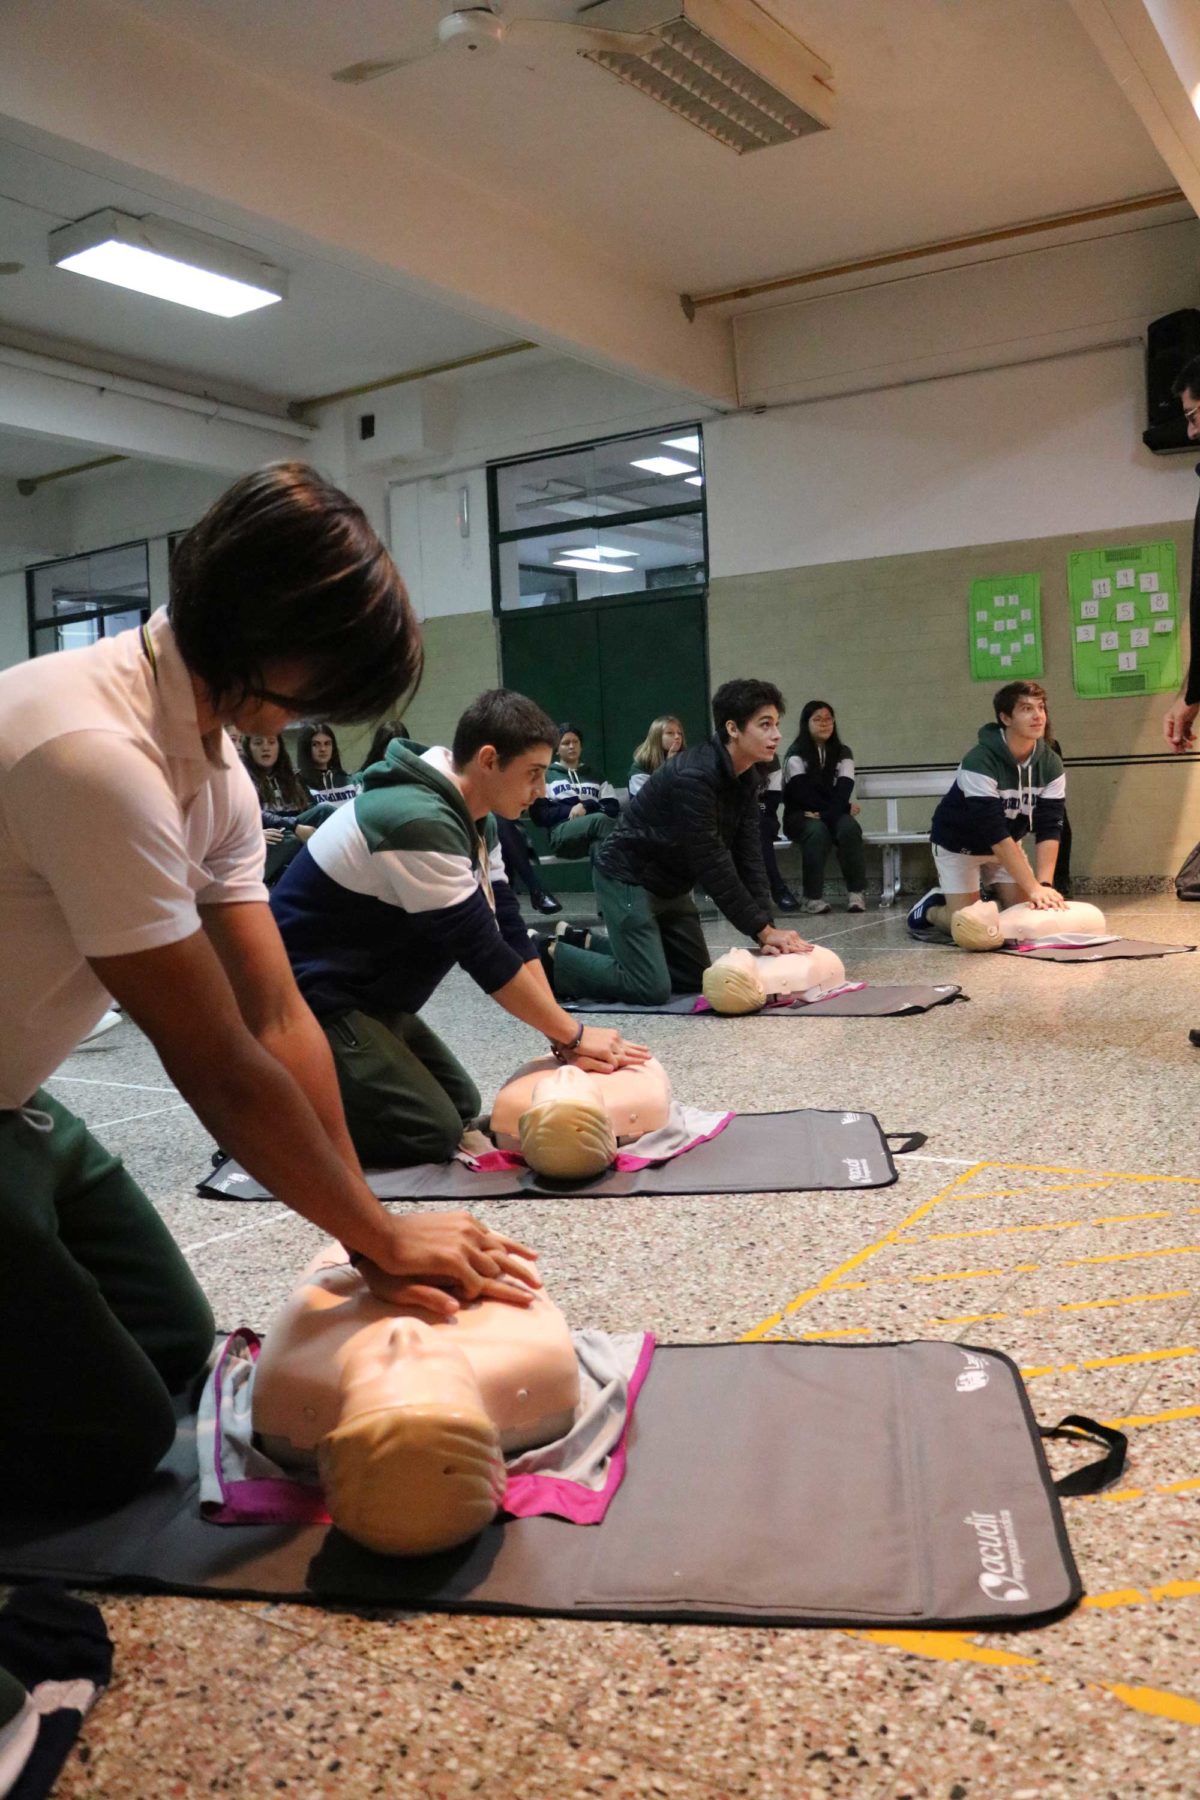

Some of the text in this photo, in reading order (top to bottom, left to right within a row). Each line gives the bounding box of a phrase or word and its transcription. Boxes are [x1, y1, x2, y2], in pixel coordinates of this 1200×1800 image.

[1097, 582, 1108, 594] 11
[1155, 595, 1164, 609] 8
[1085, 604, 1097, 616] 10
[1120, 604, 1131, 618] 5
[1082, 628, 1091, 640] 3
[1105, 634, 1115, 646] 6
[1135, 631, 1144, 643] 2
[963, 1510, 1007, 1574] acudir
